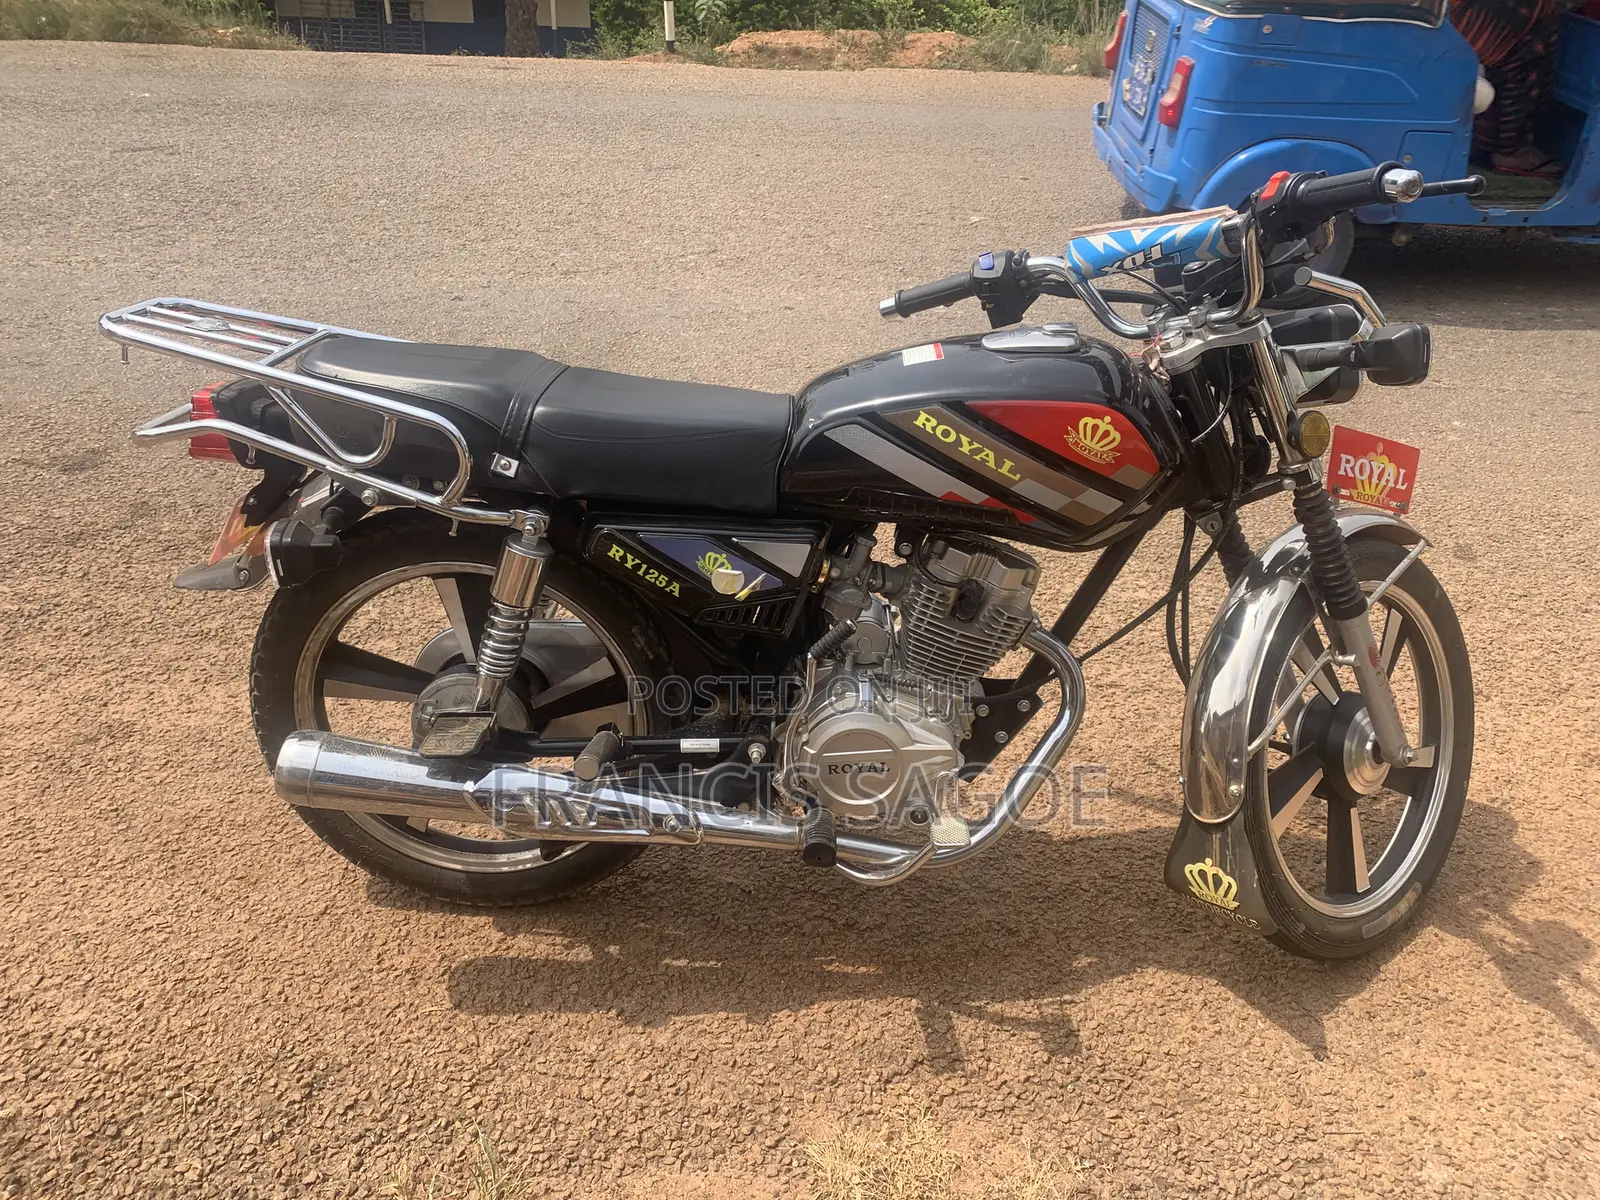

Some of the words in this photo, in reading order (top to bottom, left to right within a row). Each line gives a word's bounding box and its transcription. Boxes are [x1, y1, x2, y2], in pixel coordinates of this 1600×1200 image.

[913, 410, 1021, 482] ROYAL
[1072, 438, 1109, 460] ROYAL
[1338, 453, 1408, 490] ROYAL
[1355, 490, 1389, 505] ROYAL
[607, 543, 681, 597] RY125A
[827, 761, 891, 775] ROYAL
[1181, 893, 1261, 931] MOTORCYCLE
[1198, 890, 1231, 908] ROYAL
